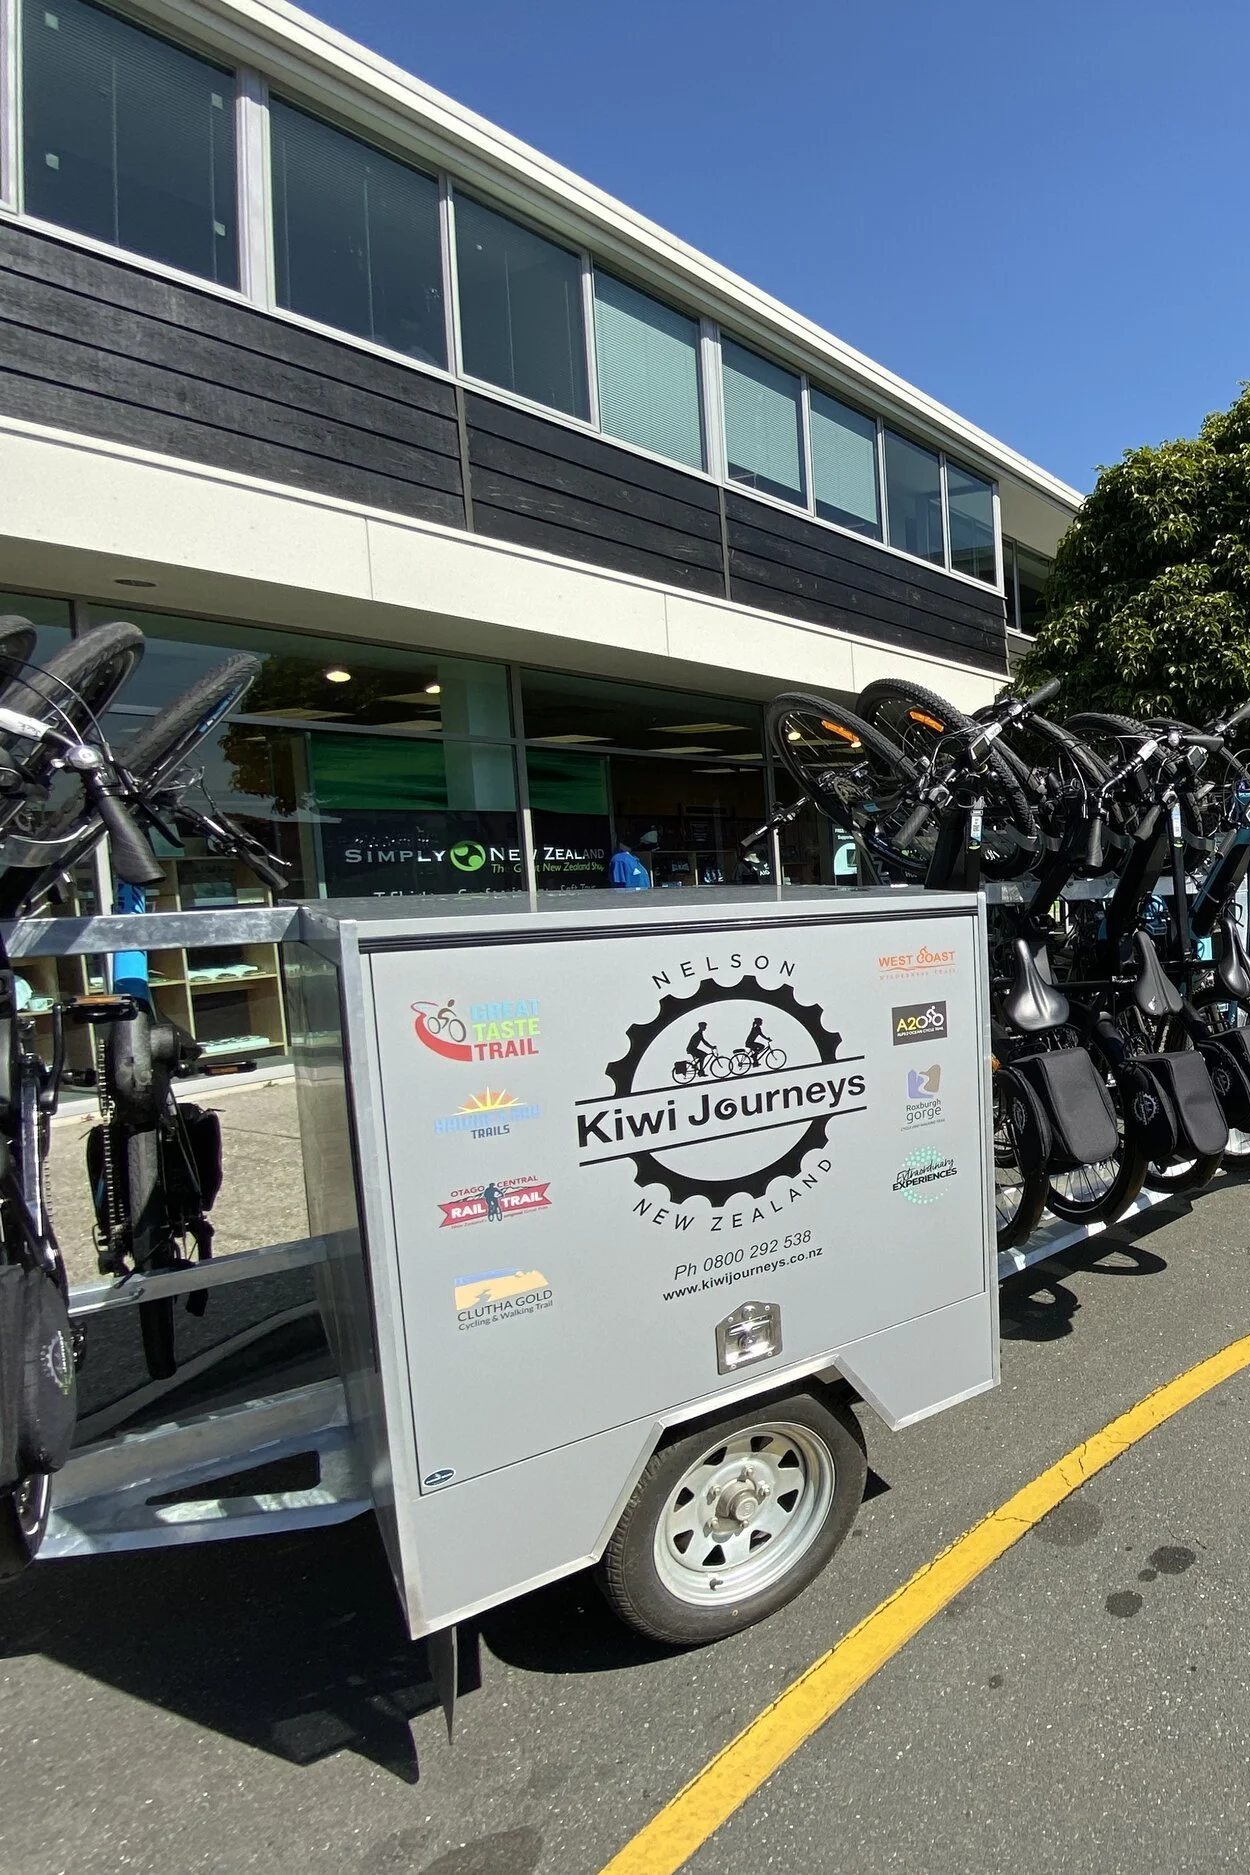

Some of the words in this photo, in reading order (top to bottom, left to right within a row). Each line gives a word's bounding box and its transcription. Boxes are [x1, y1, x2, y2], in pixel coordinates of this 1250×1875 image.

[344, 849, 447, 863] SIMPLY
[490, 847, 538, 861] NE
[544, 847, 605, 860] ZEALAND
[542, 863, 561, 872] New
[563, 862, 590, 871] Zealand
[879, 954, 913, 968] WEST
[916, 950, 956, 964] COAST
[651, 953, 796, 990] NELSON
[470, 998, 540, 1022] GREAT
[472, 1018, 541, 1042] TASTE
[474, 1038, 540, 1061] TRAIL
[576, 1099, 677, 1148] Kiwi
[688, 1074, 867, 1128] Journeys
[906, 1098, 942, 1112] Roxburgh
[906, 1106, 942, 1124] gorge
[471, 1124, 510, 1139] TRAILS
[892, 1168, 958, 1191] EXPERIENCES
[896, 1158, 954, 1182] Extraordinary
[450, 1185, 485, 1198] OTAGO
[497, 1175, 539, 1189] CENTRAL
[632, 1198, 695, 1231] NEW
[710, 1159, 832, 1231] ZEALAND
[451, 1203, 486, 1219] RAIL
[501, 1191, 544, 1208] TRAIL
[674, 1262, 697, 1280] Ph
[703, 1249, 744, 1272] 0800
[750, 1239, 778, 1259] 292
[783, 1230, 812, 1249] 538
[662, 1246, 824, 1301] www.kiwijourneys.co.nz
[457, 1300, 513, 1322] CLUTHA
[515, 1289, 553, 1306] GOLD
[458, 1315, 491, 1331] Cycling
[492, 1312, 499, 1322] &
[500, 1306, 534, 1320] Walking
[535, 1300, 553, 1311] Trail
